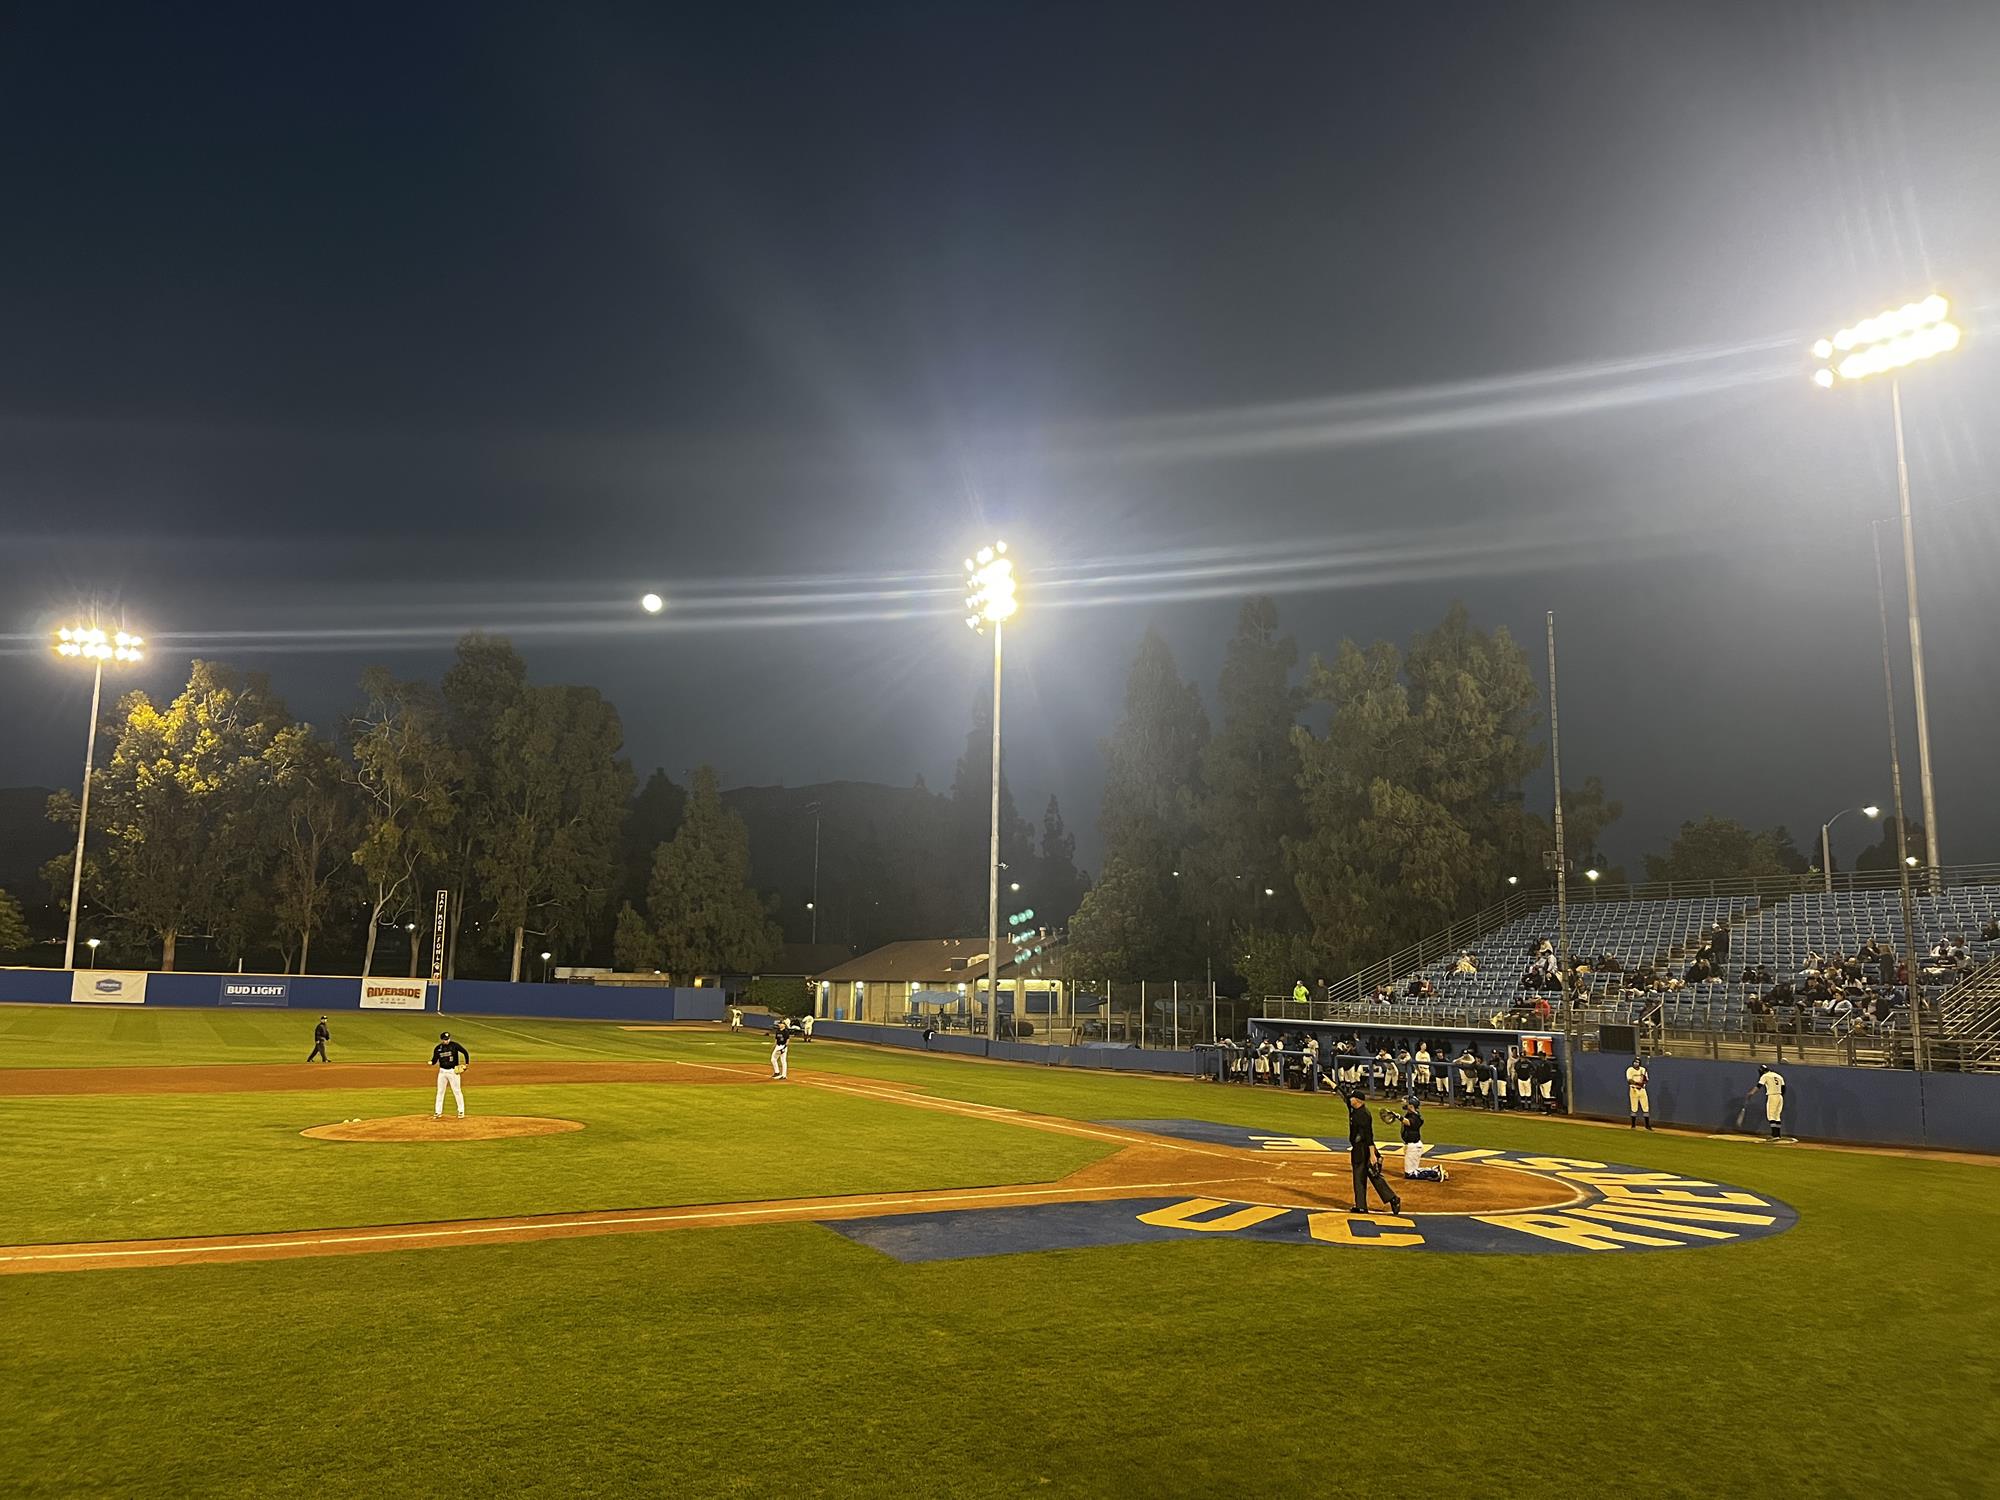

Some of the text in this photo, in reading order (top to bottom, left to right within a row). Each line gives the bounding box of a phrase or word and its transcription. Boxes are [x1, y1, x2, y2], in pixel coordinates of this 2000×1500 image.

[226, 985, 283, 995] BUD LIGHT
[367, 986, 421, 999] RIVERSIDE
[1136, 1198, 1426, 1247] UC
